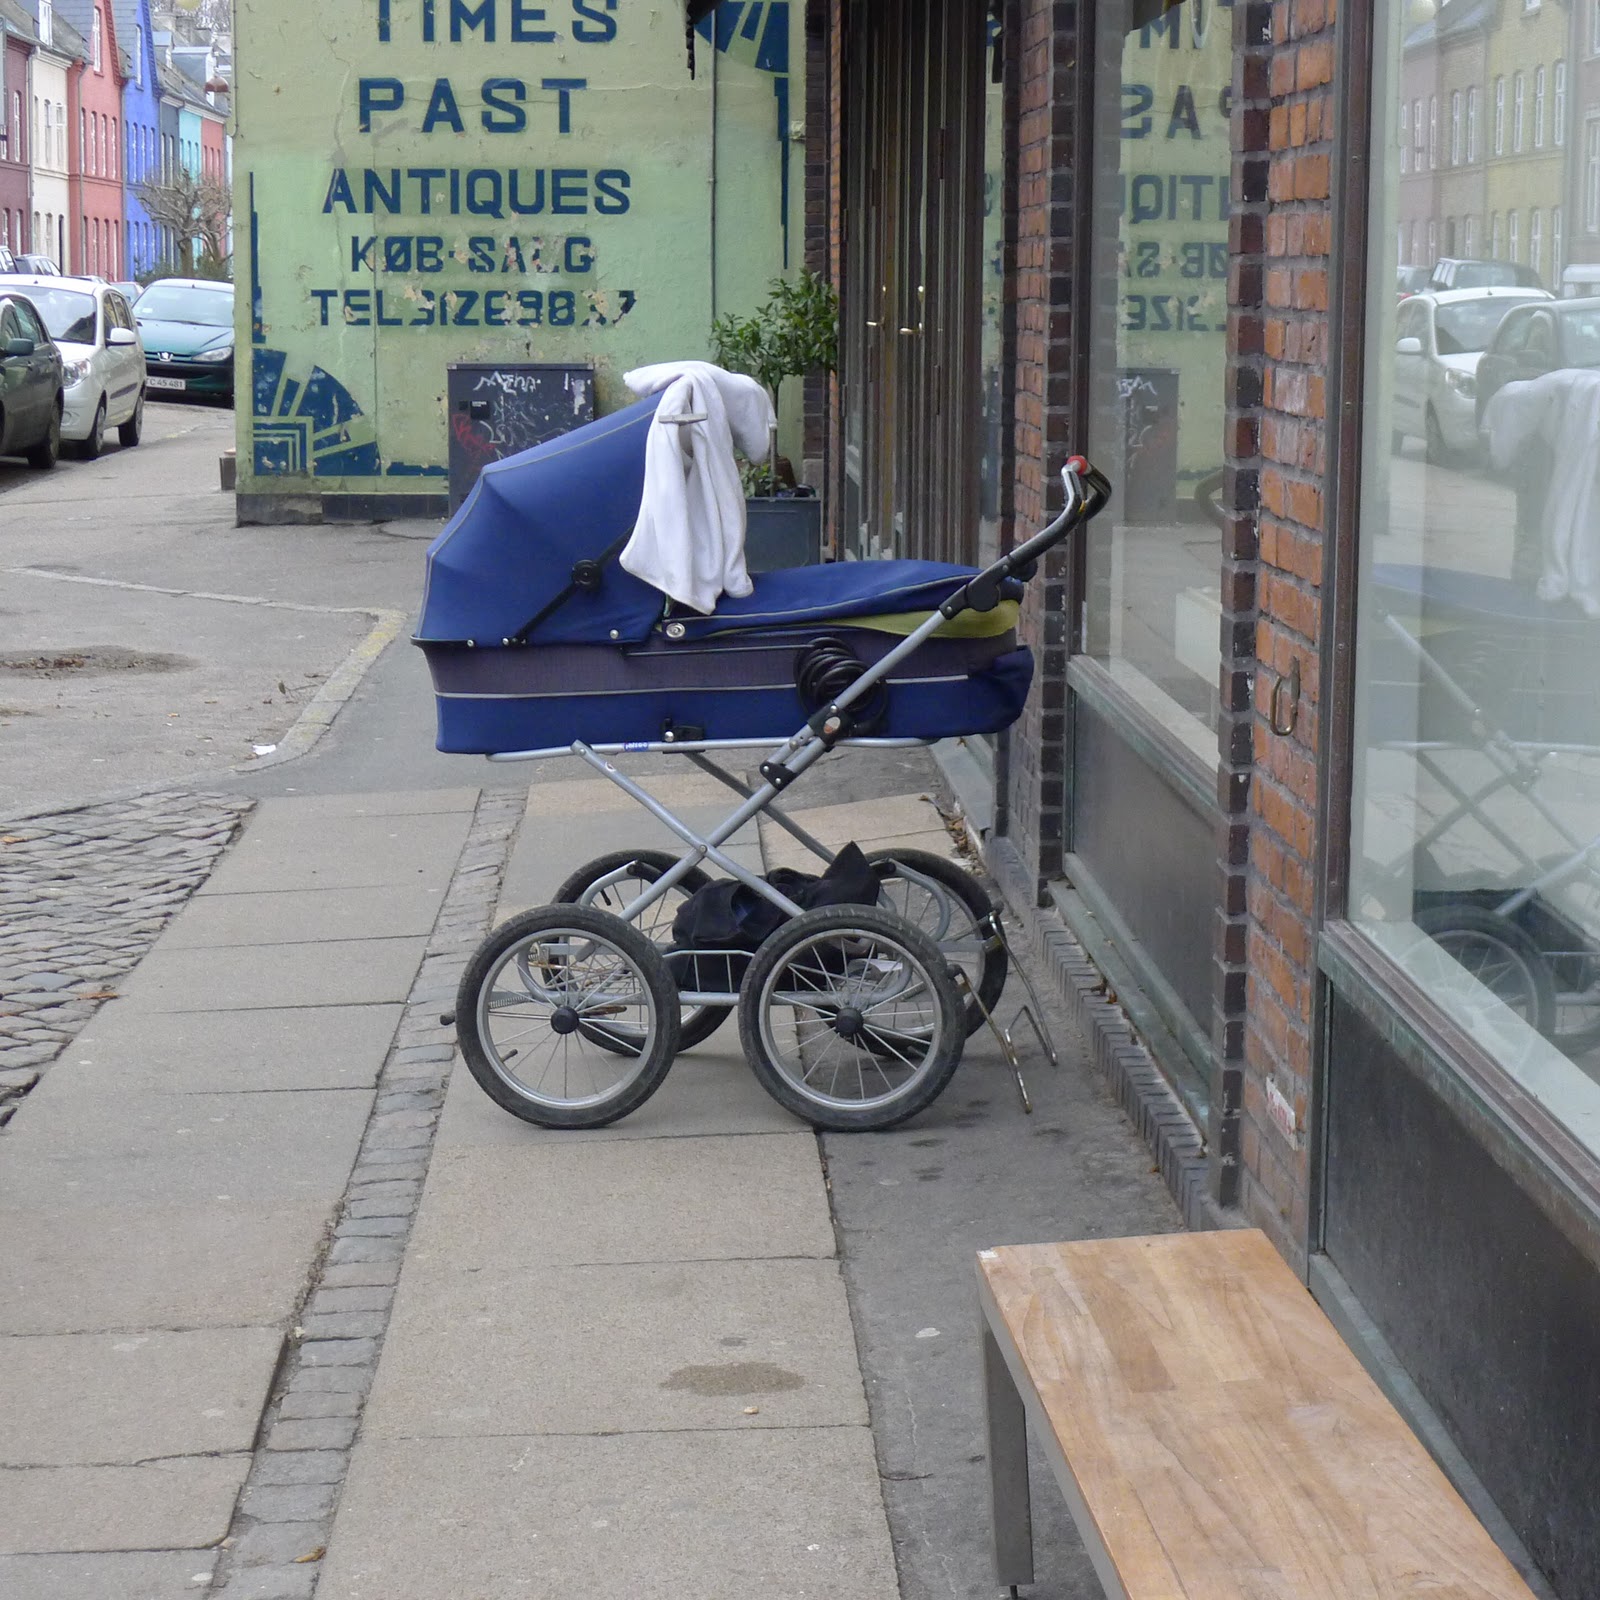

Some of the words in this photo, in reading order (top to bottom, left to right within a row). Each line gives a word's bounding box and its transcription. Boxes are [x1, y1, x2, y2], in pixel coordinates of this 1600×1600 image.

[376, 0, 618, 42] TIMES
[358, 77, 587, 133] PAST
[322, 168, 632, 219] ANTIQUES
[310, 289, 402, 326] TEL
